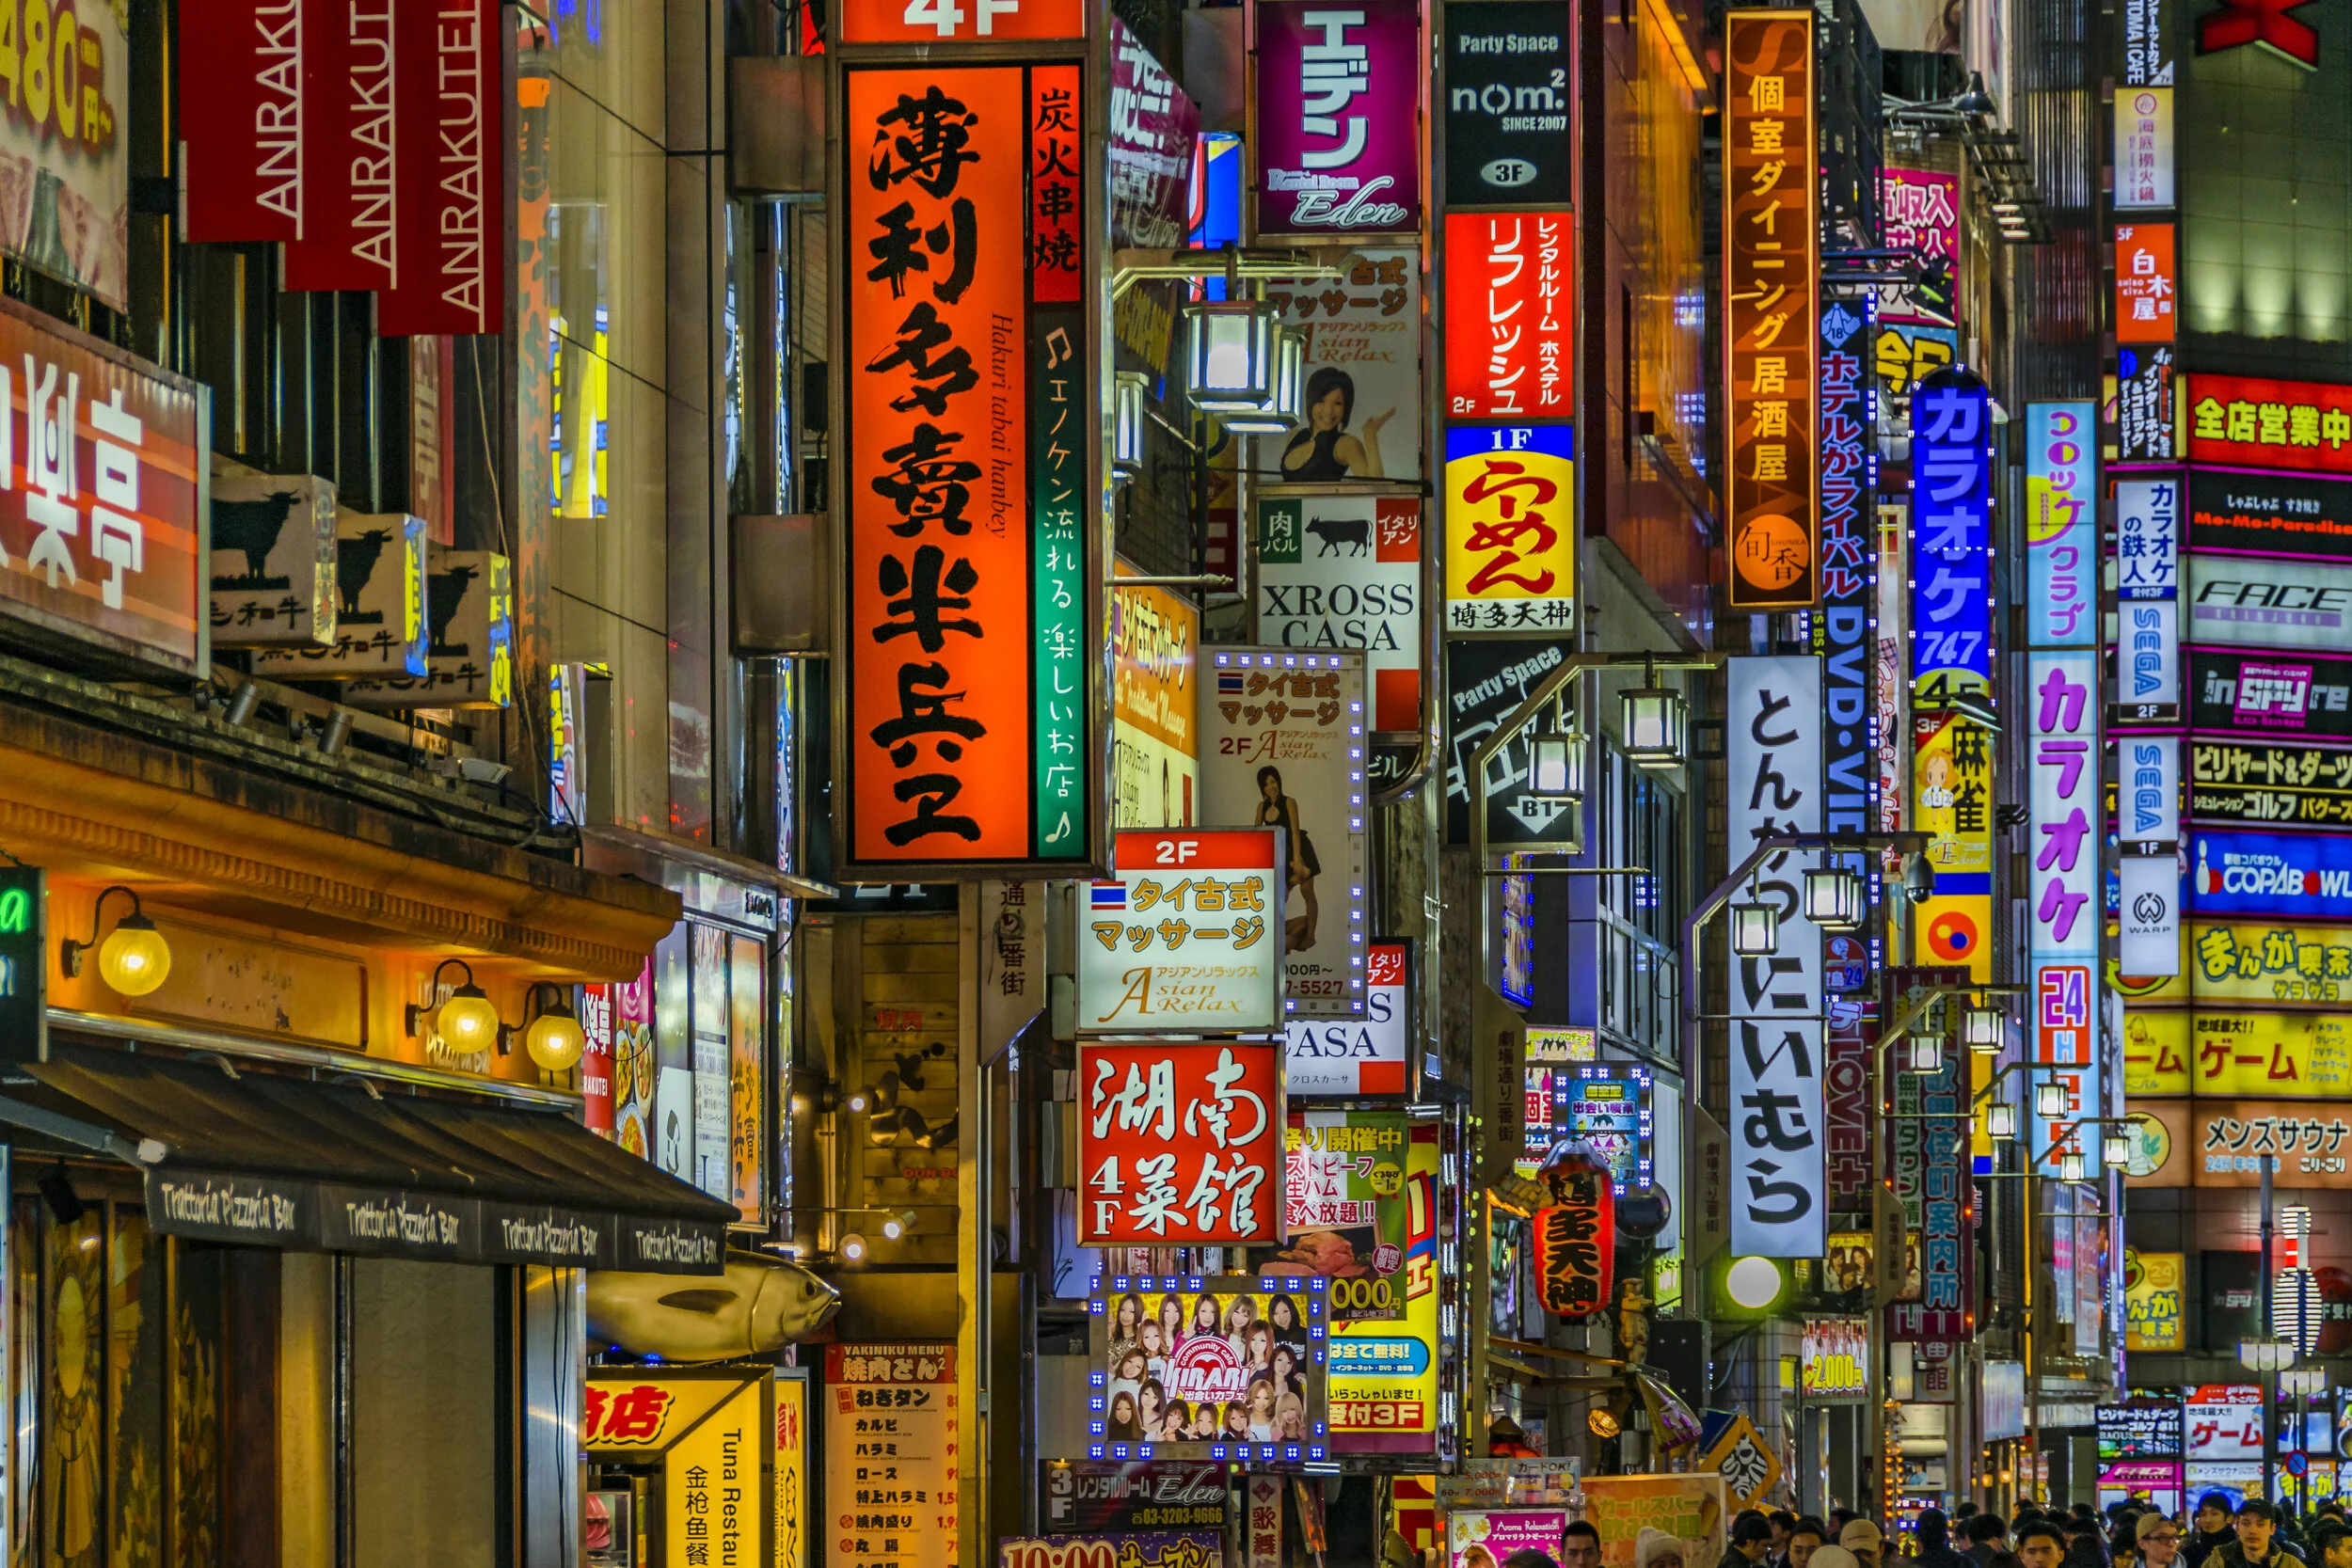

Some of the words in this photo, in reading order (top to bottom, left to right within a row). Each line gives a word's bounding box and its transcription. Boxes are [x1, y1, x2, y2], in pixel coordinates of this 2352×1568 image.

[1459, 35, 1505, 54] Party
[1506, 34, 1560, 54] Space
[1301, 10, 1370, 169] エデン
[1502, 117, 1536, 132] SINCE
[1537, 116, 1567, 132] 2007
[438, 10, 483, 314] ANRAKUTEI
[1495, 164, 1523, 182] 3F
[1034, 87, 1080, 273] 炭火串焼
[1290, 175, 1407, 230] Eden
[1748, 74, 1788, 482] 個室ダイニング居酒屋
[1268, 287, 1408, 319] マッサージ
[1488, 217, 1526, 414] リフレッシュ
[992, 312, 1013, 389] Hakuri
[1318, 349, 1396, 364] Relax
[1453, 396, 1476, 414] 2F
[2144, 364, 2159, 458] インターネット
[992, 397, 1013, 453] tabai
[1490, 428, 1533, 451] 1F
[2194, 396, 2351, 450] 全店営業中
[1821, 350, 1866, 599] ホテルがライバル
[985, 457, 1013, 539] hanbey
[1923, 388, 1981, 623] カラオケ
[1269, 511, 1293, 538] 肉
[2151, 483, 2174, 583] カラオケ
[1263, 539, 1298, 553] バル
[1740, 526, 1807, 581] 旬香
[2122, 516, 2147, 583] の鉄人
[1262, 583, 1414, 616] XROSS
[2049, 546, 2088, 637] クラブ
[2196, 579, 2352, 612] FACE
[1451, 600, 1572, 629] 博多天神
[1281, 619, 1401, 651] CASA
[1920, 631, 1982, 665] 747
[2134, 608, 2162, 697] SEGA
[1246, 671, 1341, 700] タイ古式
[1453, 674, 1505, 714] Party
[1500, 645, 1563, 688] Space
[1217, 700, 1341, 726] マッサージ
[1916, 718, 1942, 734] 3F
[2137, 705, 2158, 718] 2F
[1219, 736, 1253, 756] 2F
[1279, 750, 1332, 761] Relax
[1951, 722, 1987, 834] 麻雀
[2193, 746, 2352, 788] ビリヤード&ダーツ
[2036, 667, 2090, 942] カラオケ
[2135, 745, 2163, 834] SEGA
[1522, 800, 1553, 817] B1
[1155, 841, 1200, 863] 2F
[2138, 842, 2159, 854] 1F
[1132, 876, 1265, 911] タイ古式
[1091, 915, 1265, 953] マッサージ
[2128, 926, 2171, 934] WARP
[2197, 927, 2352, 982] まんが喫茶
[1156, 965, 1260, 978] アジアンリラックス
[1156, 996, 1247, 1014] Relax
[2041, 970, 2087, 1027] 24
[2200, 1038, 2300, 1082] ゲーム
[1292, 1075, 1349, 1085] クロスカーサ
[1497, 1030, 1516, 1142] 劇場通り一番街
[2204, 1117, 2350, 1154] メンズサウナ
[843, 1345, 905, 1355] YAKINIKU
[908, 1345, 945, 1355] MENU
[1180, 1341, 1221, 1367] community
[1220, 1349, 1234, 1366] cafe
[1164, 1357, 1251, 1399] KIRARI
[856, 1388, 930, 1407] ねぎタン
[1184, 1390, 1247, 1402] 出会いカフェ
[855, 1418, 898, 1432] カルビ
[2192, 1420, 2264, 1448] ゲーム
[722, 1428, 742, 1481] Tuna
[855, 1443, 898, 1456] ハラミ
[855, 1467, 898, 1480] ロース
[1076, 1474, 1152, 1499] レンタルルーム
[1153, 1464, 1226, 1505] Eden
[855, 1490, 927, 1504] 特上ハラミ
[1050, 1468, 1073, 1519] 3F
[855, 1514, 913, 1528] 焼肉盛り
[1142, 1506, 1223, 1525] 03-3203-9666
